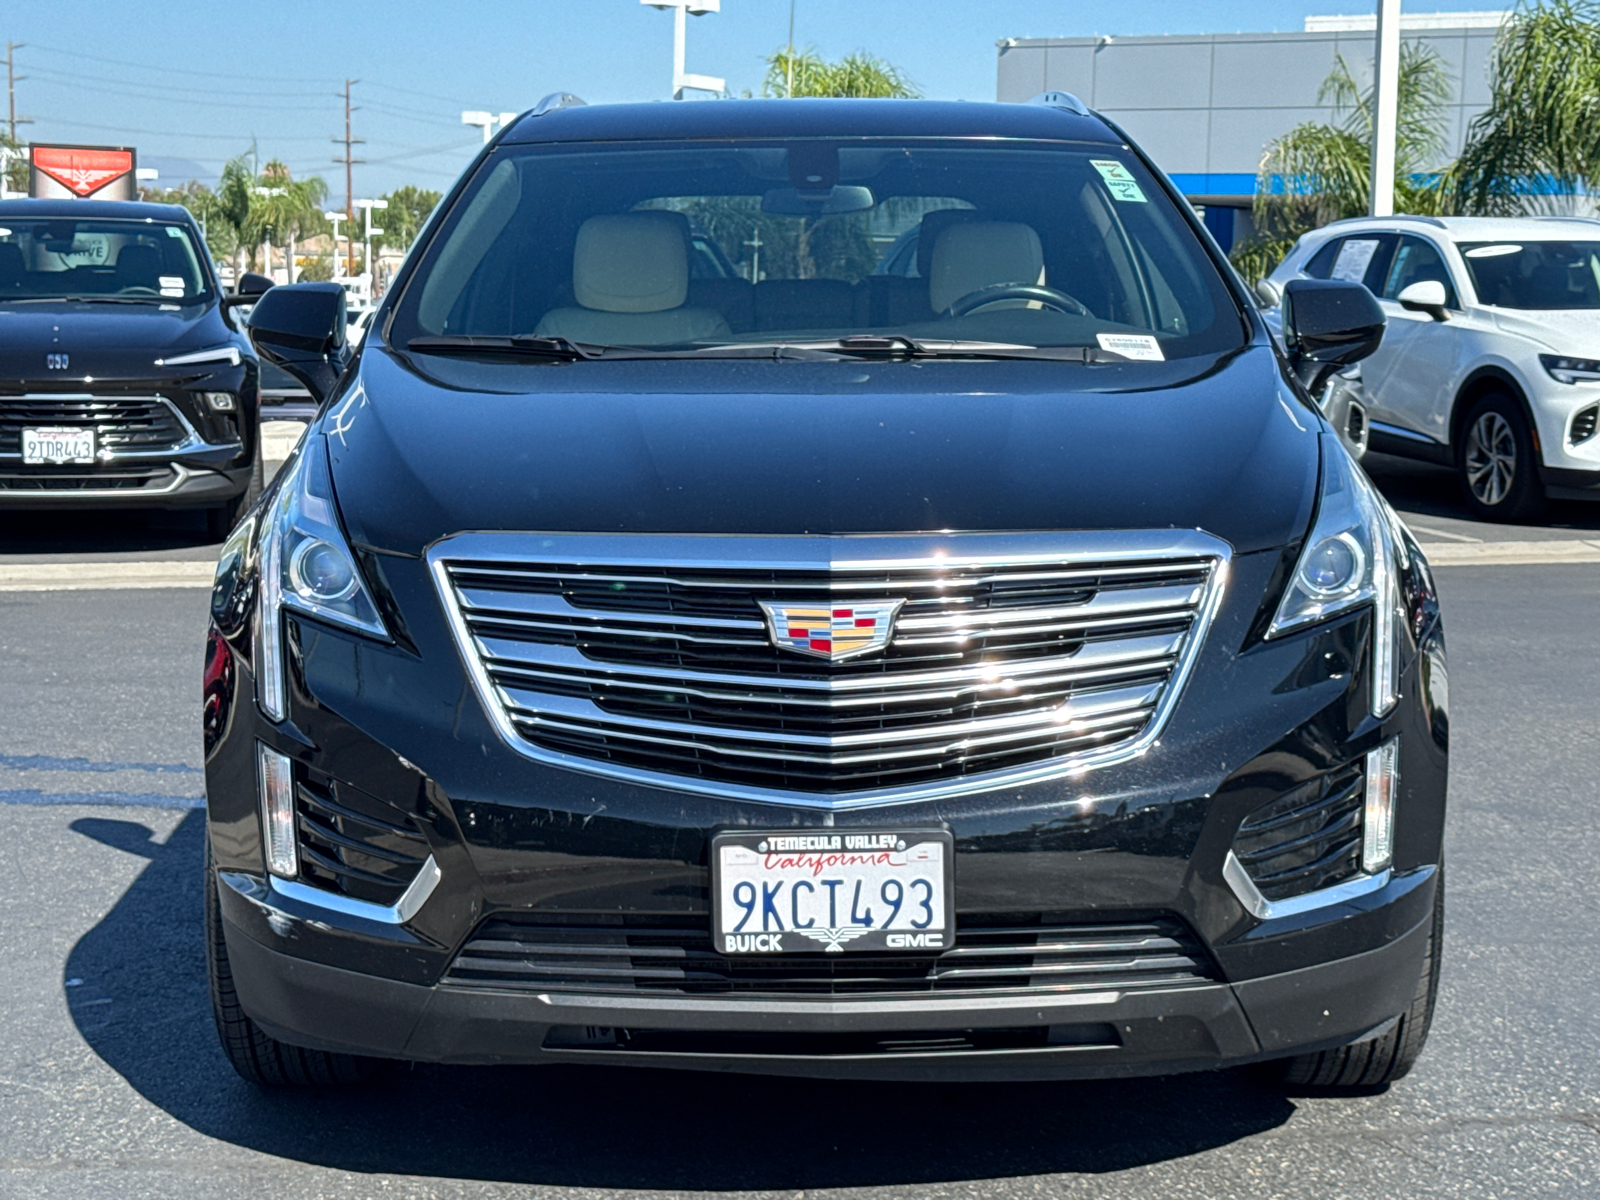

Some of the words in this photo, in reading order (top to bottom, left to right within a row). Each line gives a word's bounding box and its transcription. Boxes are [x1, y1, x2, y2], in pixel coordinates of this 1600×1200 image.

[28, 441, 90, 458] 9TDR443
[767, 836, 842, 851] TEMECULA
[845, 835, 898, 850] VALLEY
[763, 851, 907, 877] California
[732, 878, 934, 932] 9KCT493
[725, 934, 783, 952] BUICK
[886, 933, 944, 947] GMC
